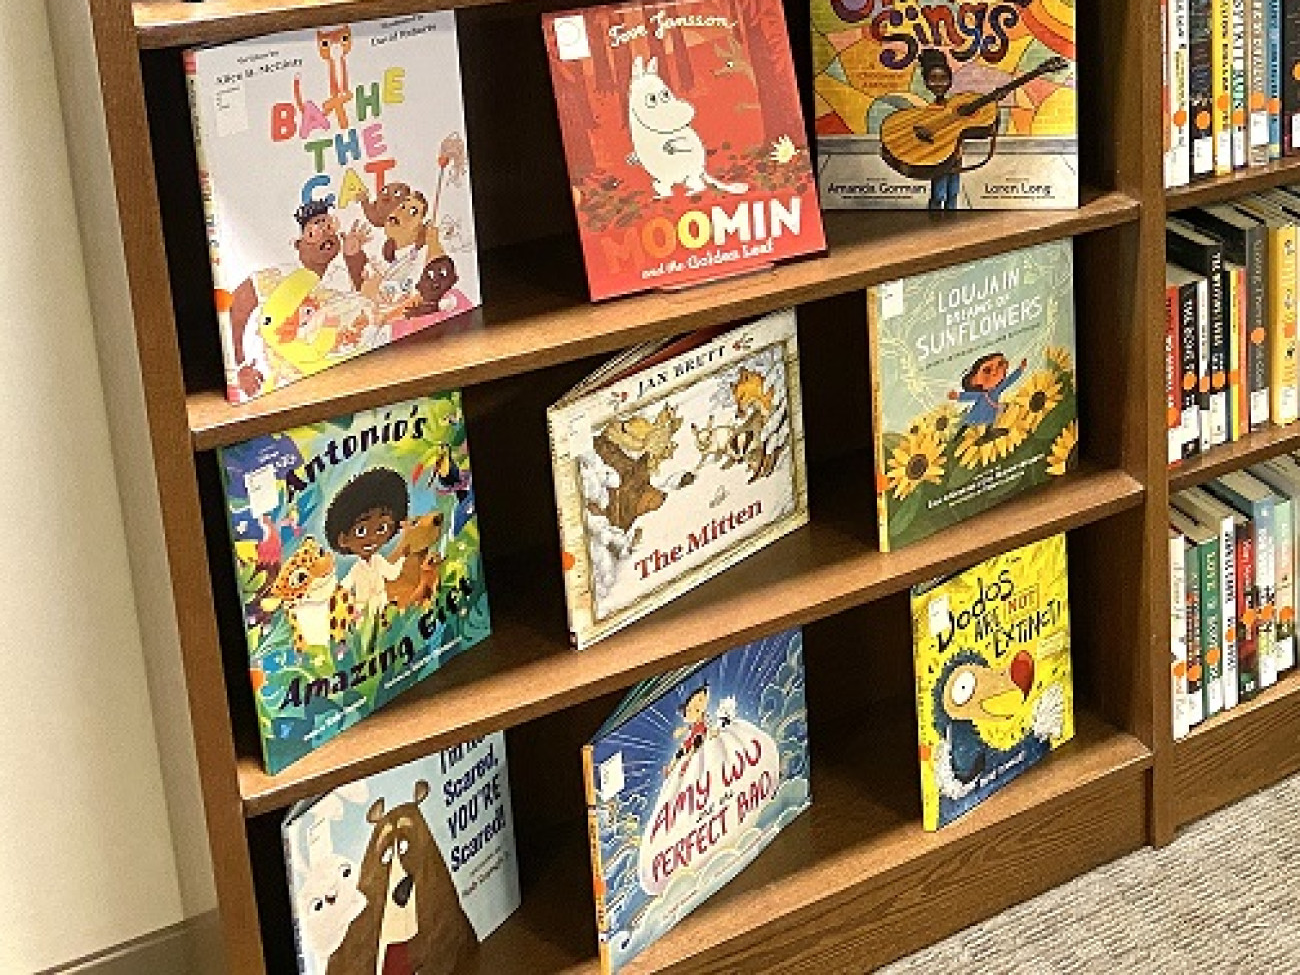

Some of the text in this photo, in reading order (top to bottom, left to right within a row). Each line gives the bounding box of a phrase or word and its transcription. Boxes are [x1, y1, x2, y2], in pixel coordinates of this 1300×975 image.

[650, 9, 738, 39] Jansson
[270, 67, 406, 143] BATHE
[304, 124, 387, 173] THE
[300, 157, 396, 210] CAT
[827, 182, 927, 195] Amanda Gorman
[984, 182, 1052, 196] Loren Long
[600, 196, 801, 275] MOOMIN
[642, 264, 664, 280] and
[687, 250, 740, 270] Golden
[742, 236, 775, 257] Leaf
[937, 268, 1020, 314] LOUJAIN
[915, 296, 1042, 362] SUNFLOWERS
[636, 344, 727, 399] JAN BRETT
[285, 405, 428, 503] Antonio's
[634, 499, 763, 581] The Mitten
[929, 568, 1015, 654] Dodos
[279, 635, 414, 711] Amazing
[721, 739, 763, 788] WU
[446, 773, 502, 840] YOU'RE
[652, 805, 731, 884] PERFECT
[735, 771, 781, 824] BAO
